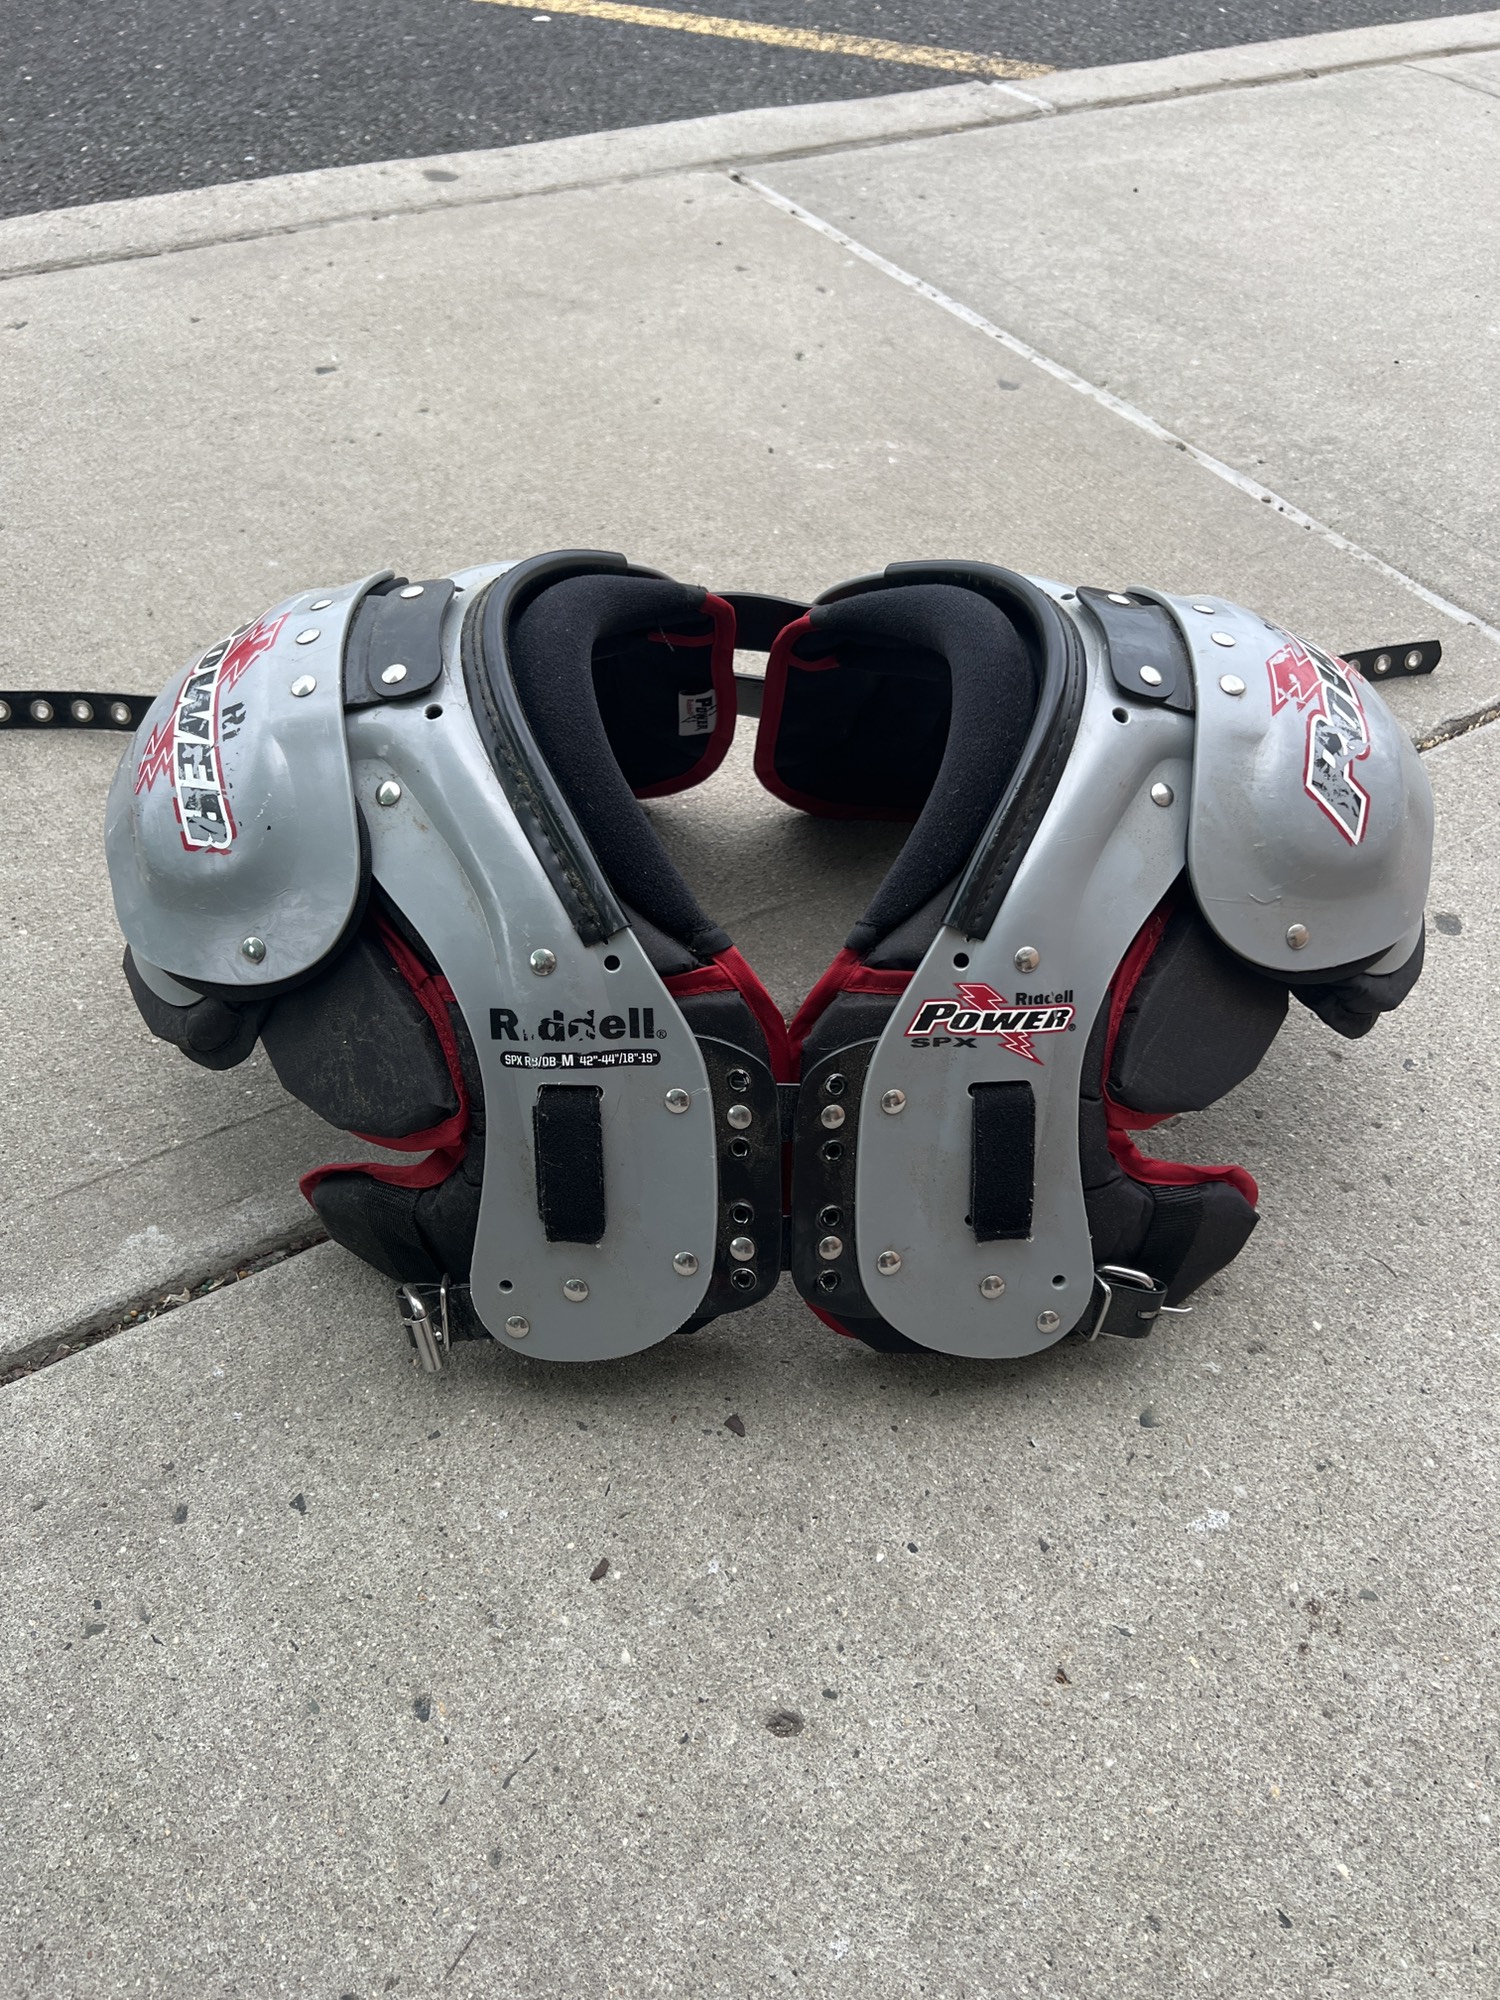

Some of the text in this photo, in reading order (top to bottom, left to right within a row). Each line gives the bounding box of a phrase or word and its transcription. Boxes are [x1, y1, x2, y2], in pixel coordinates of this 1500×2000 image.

[907, 1000, 1074, 1035] POWER
[910, 1036, 978, 1049] SPX
[504, 1054, 523, 1067] SPX
[561, 1054, 575, 1067] M
